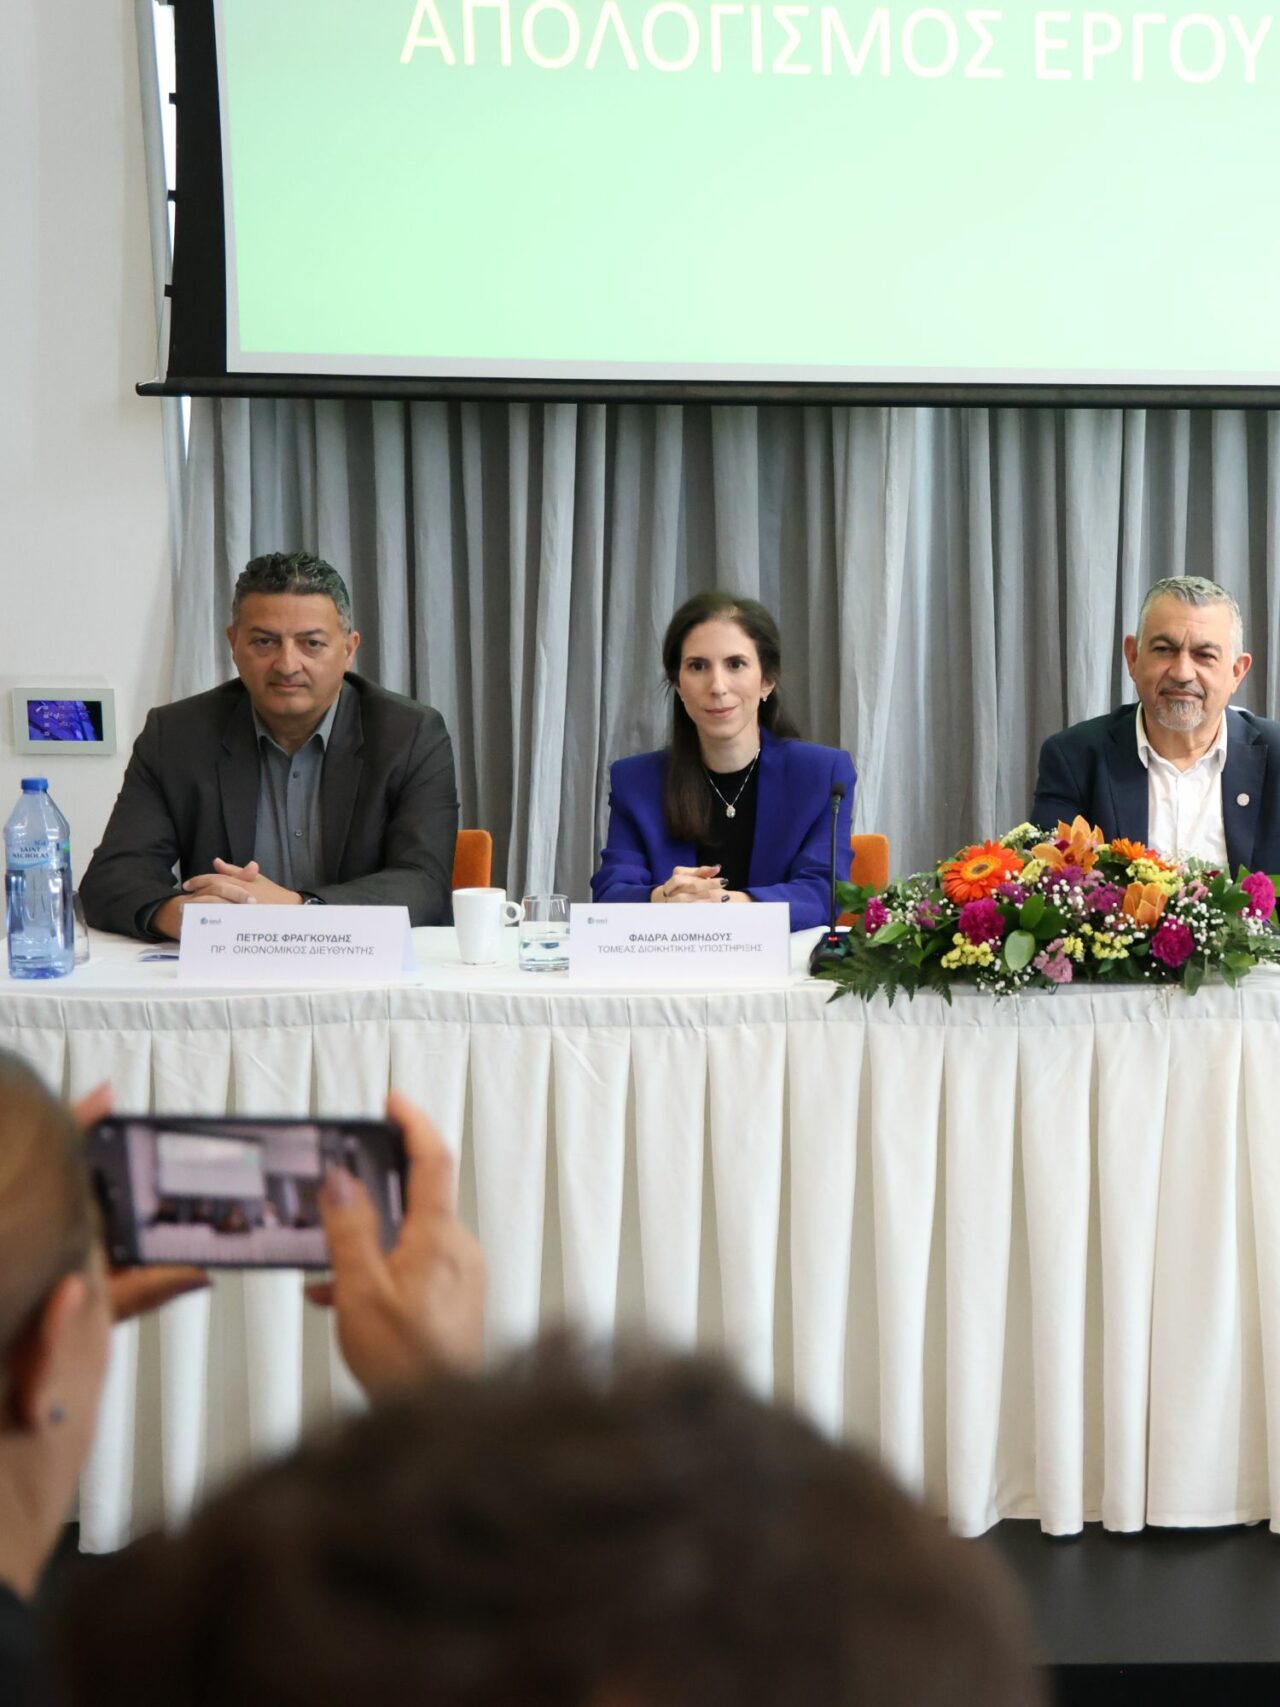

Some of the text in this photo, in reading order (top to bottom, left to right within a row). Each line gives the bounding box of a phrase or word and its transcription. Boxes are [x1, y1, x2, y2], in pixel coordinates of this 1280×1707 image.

[399, 0, 1274, 84] ΑΠΟΛΟΓΙΣΜΟΣ ΕΡΓΟΥ
[236, 933, 352, 943] ΠΕΤΡΟΣ ΦΡΑΓΚΟΥΔΗΣ
[629, 933, 732, 943] ΦΑΙΔΡΑ ΔΙΟΜΗΔΟΥΣ
[233, 945, 308, 955] ΟΙΚΟΝΟΜΙΚΟΣ
[309, 946, 375, 955] ΔΙΕΥΘΥΝΤΗΣ
[598, 945, 636, 954] ΤΟΜΕΑΣ
[638, 944, 696, 953] ΔΙΟΙΚΗΤΙΚΗΣ
